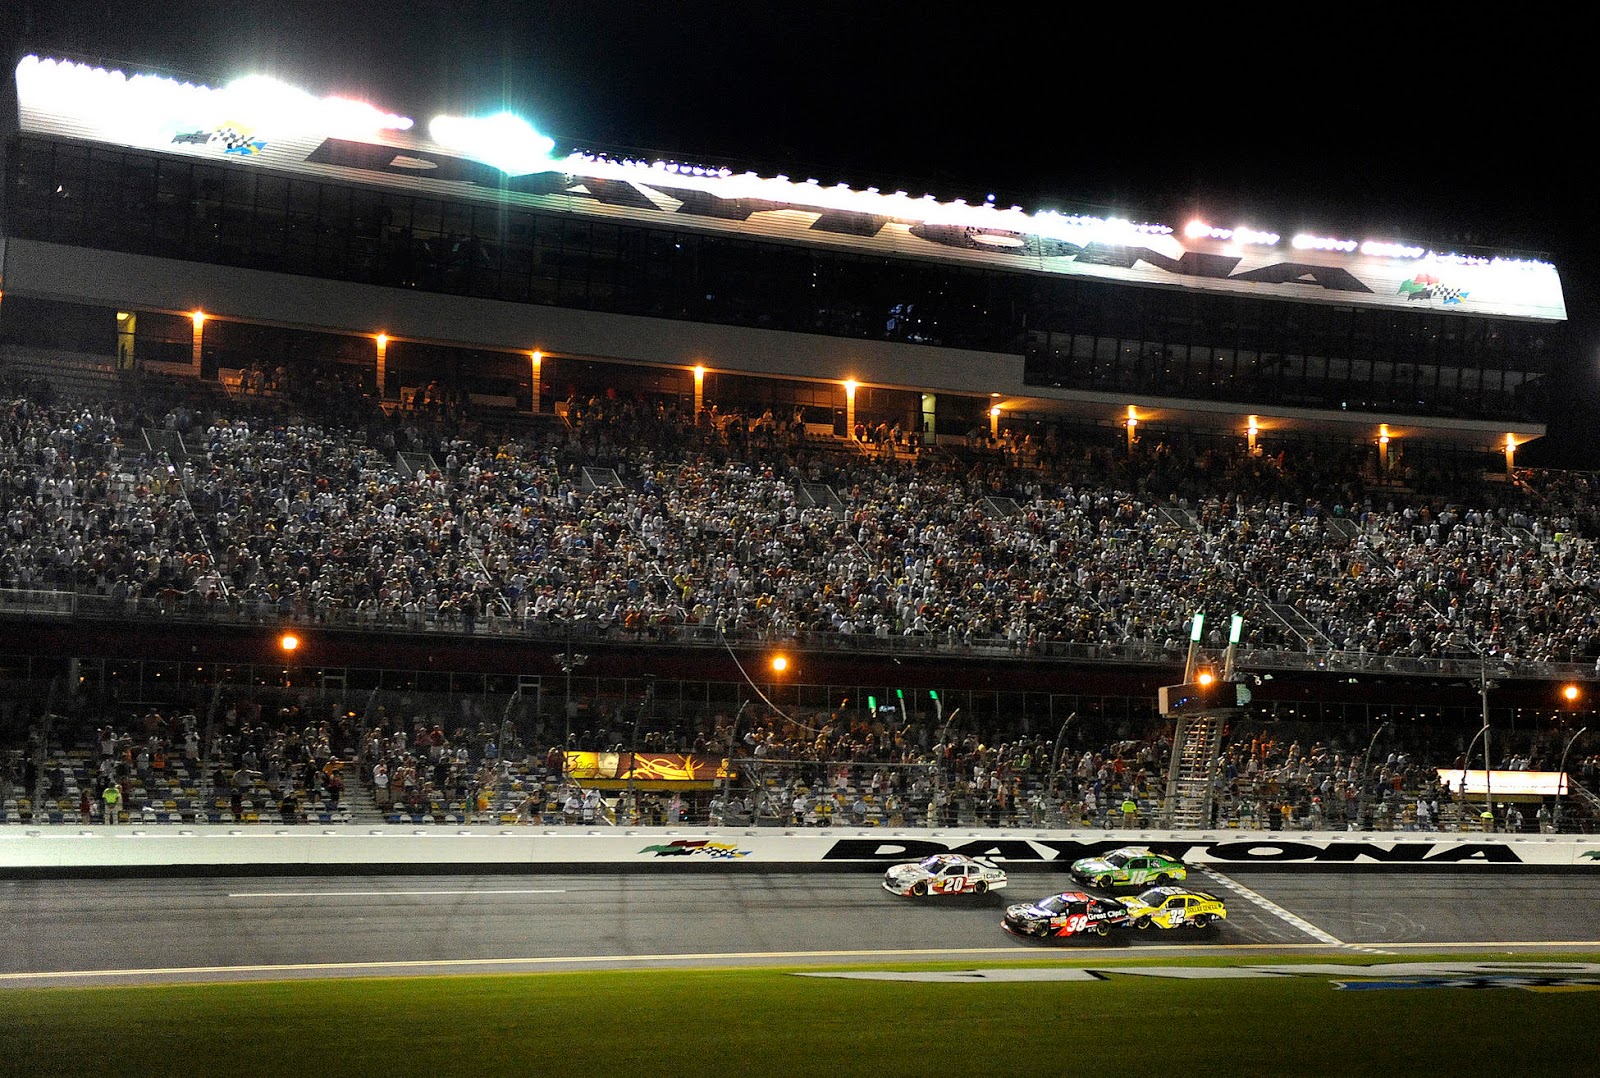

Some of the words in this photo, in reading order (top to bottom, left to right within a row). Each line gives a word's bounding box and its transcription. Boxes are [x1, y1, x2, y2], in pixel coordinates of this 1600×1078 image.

[303, 137, 1375, 294] DAYTONA
[822, 839, 1523, 865] DAYTONA
[943, 876, 964, 892] 20
[1129, 870, 1148, 885] 18
[1066, 915, 1088, 932] 38
[1087, 912, 1106, 920] Great
[1168, 909, 1185, 924] 32
